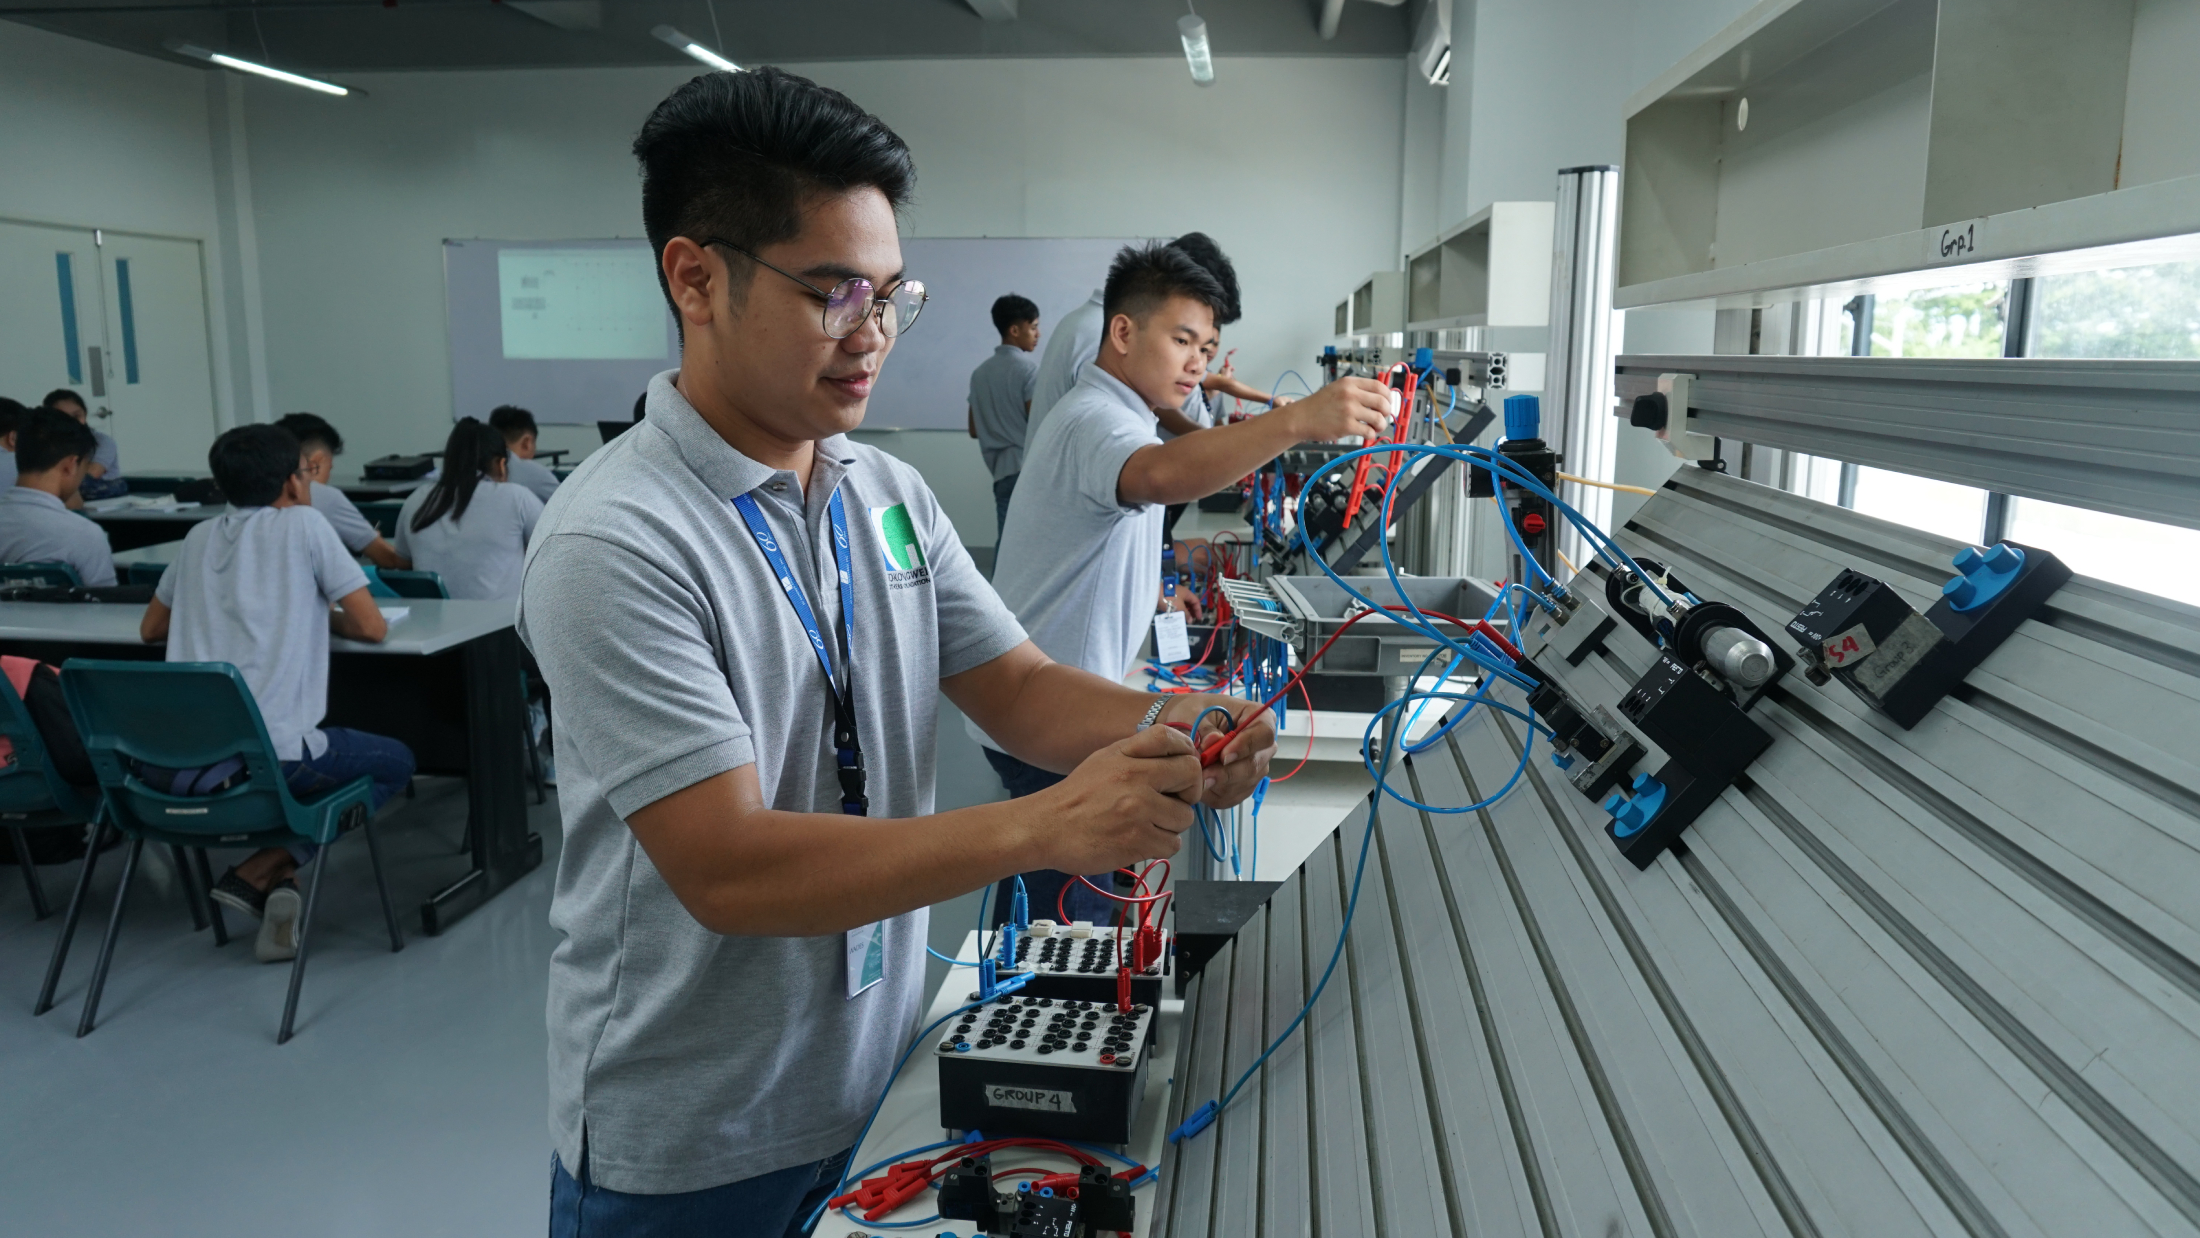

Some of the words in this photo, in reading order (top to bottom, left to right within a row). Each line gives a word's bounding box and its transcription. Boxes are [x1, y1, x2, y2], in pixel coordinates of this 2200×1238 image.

[1829, 635, 1859, 663] S4
[993, 1088, 1045, 1104] GROUP
[1049, 1093, 1062, 1111] 4
